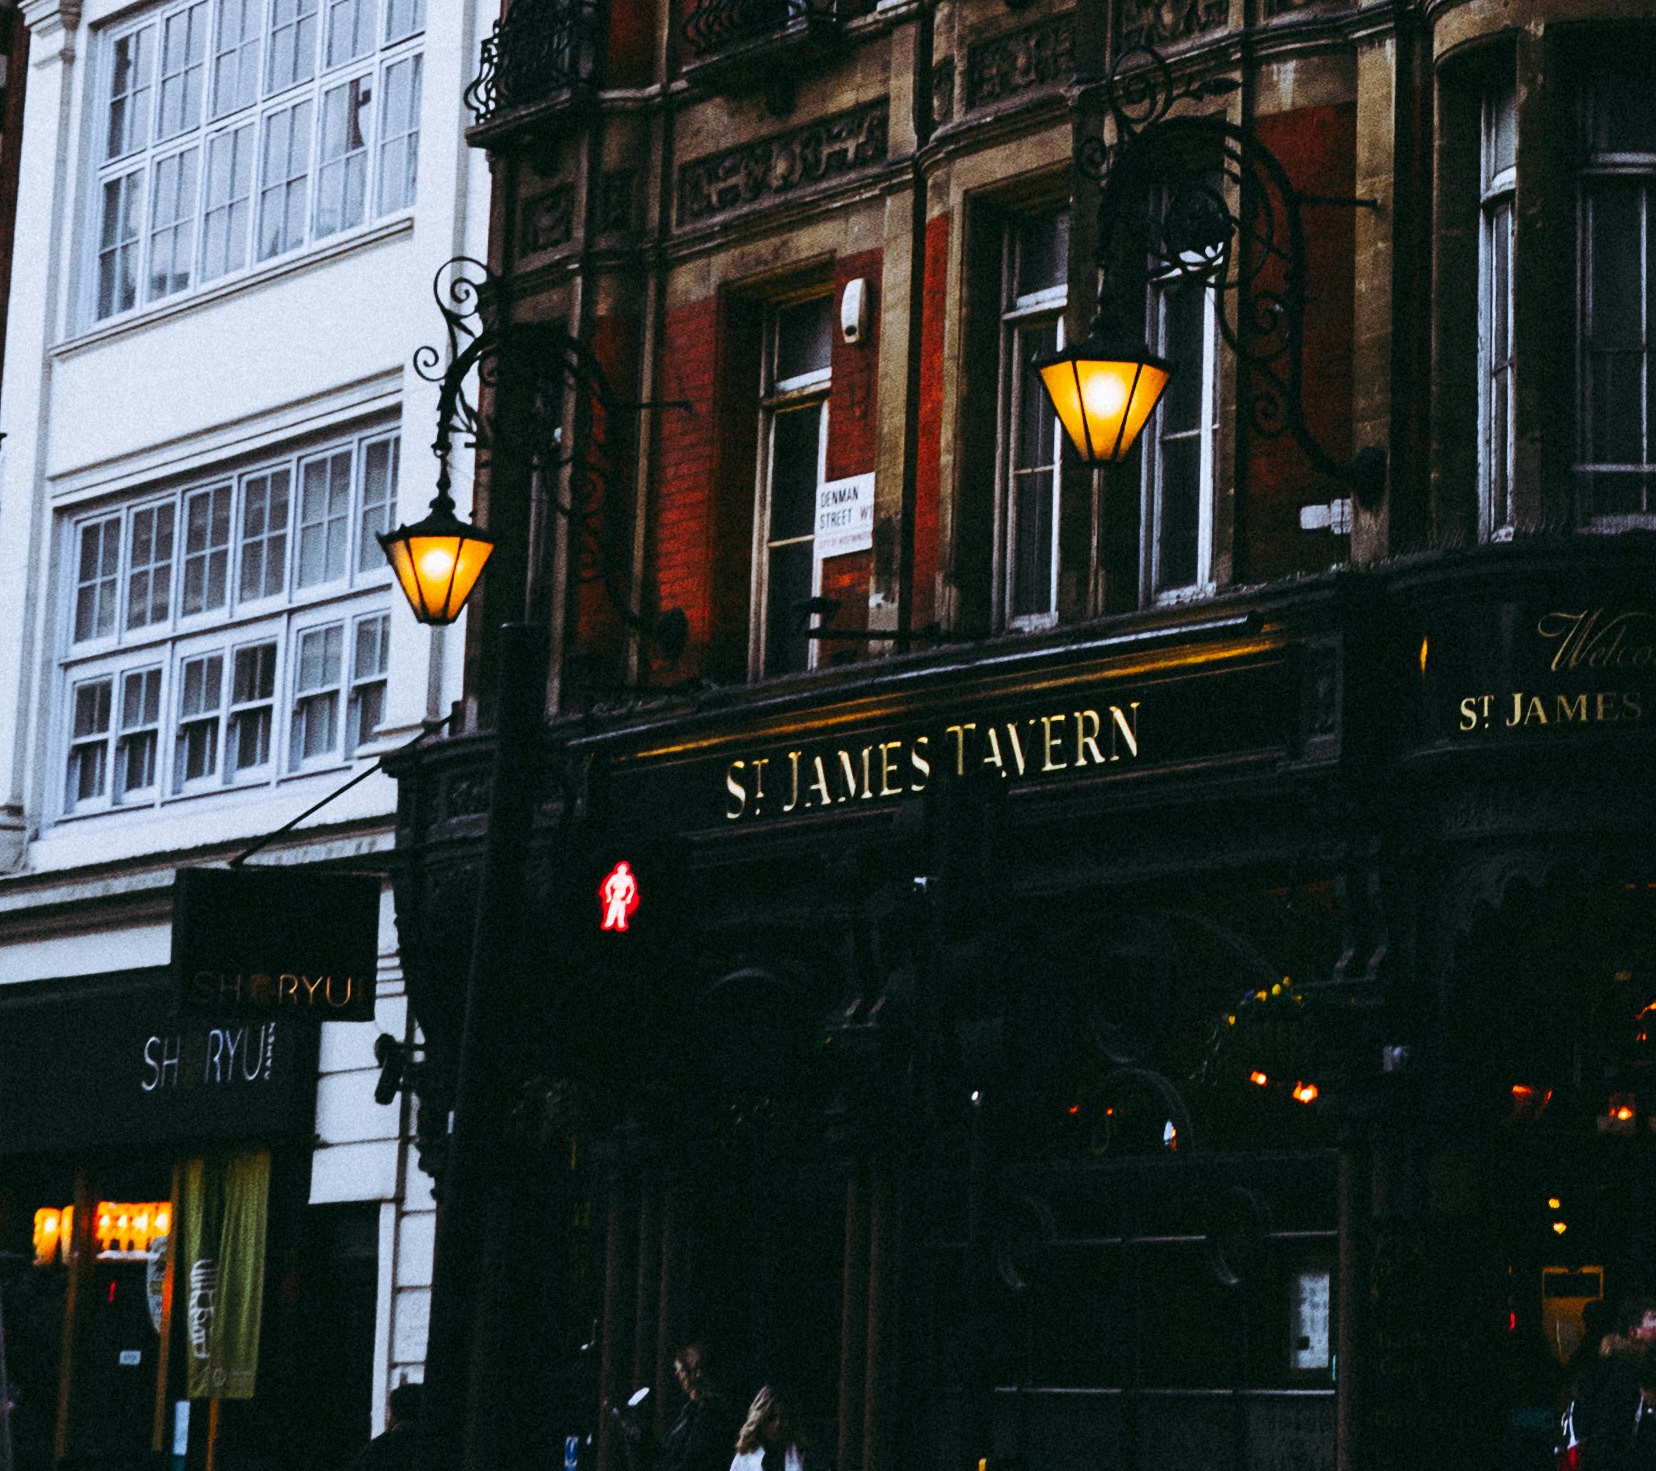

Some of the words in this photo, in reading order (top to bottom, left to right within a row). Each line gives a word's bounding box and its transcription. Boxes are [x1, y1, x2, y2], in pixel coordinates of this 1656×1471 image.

[820, 485, 859, 508] DENMAN
[819, 508, 853, 530] STREET
[1504, 690, 1644, 731] JAMES
[782, 736, 931, 813] JAMES
[946, 701, 1141, 778] TAVERN
